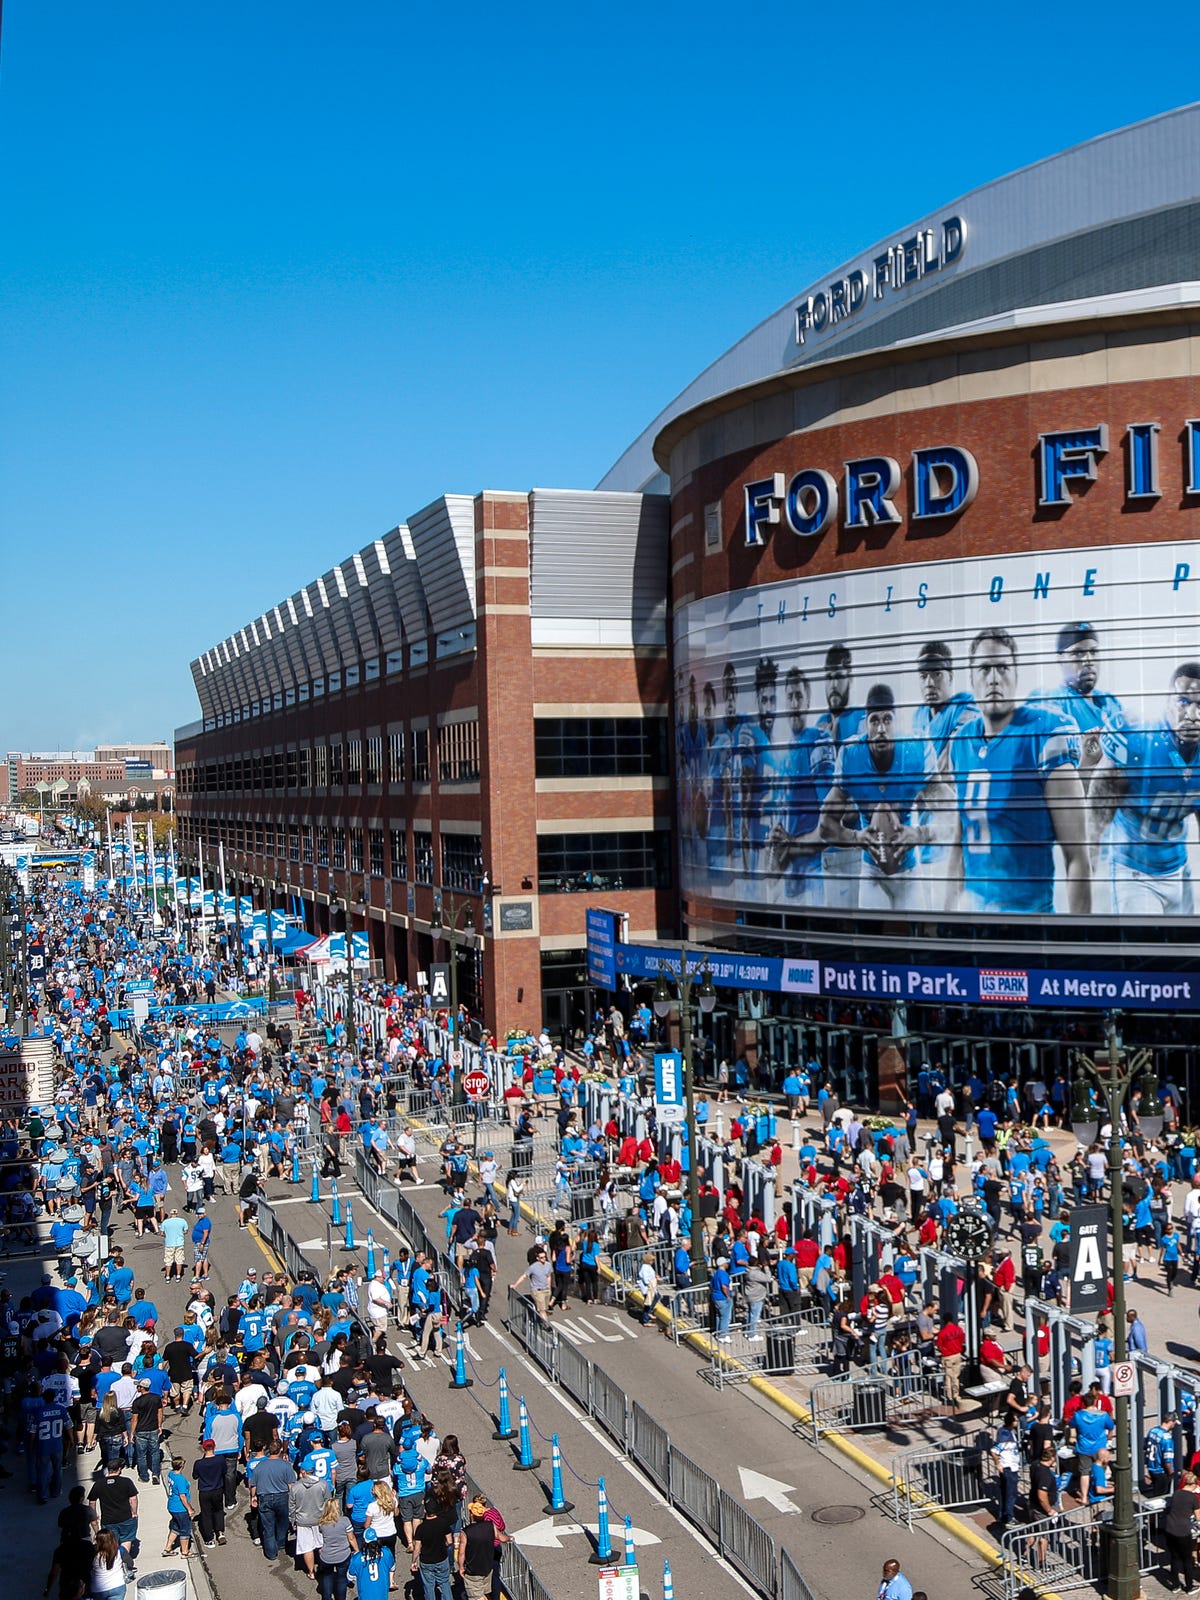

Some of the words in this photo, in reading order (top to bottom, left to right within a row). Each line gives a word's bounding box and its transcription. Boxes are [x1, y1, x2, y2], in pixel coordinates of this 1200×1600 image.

[795, 267, 869, 345] FORD
[872, 215, 968, 300] FIELD
[742, 445, 979, 548] FORD
[757, 592, 837, 628] THIS
[884, 582, 928, 612] IS
[989, 568, 1097, 603] ONE
[738, 964, 769, 981] 4:30PM
[787, 968, 815, 984] HOME
[824, 966, 857, 991] Put
[861, 968, 876, 992] it
[881, 969, 901, 993] in
[907, 970, 968, 996] Park.
[432, 976, 448, 997] A
[981, 975, 996, 991] US
[998, 977, 1026, 992] PARK
[1040, 977, 1060, 996] At
[1064, 978, 1117, 998] Metro
[1121, 980, 1191, 1001] Airport
[465, 1077, 488, 1089] STOP
[661, 1057, 677, 1102] LIONS
[207, 1086, 216, 1096] 15
[1079, 1224, 1099, 1235] GATE
[1025, 1253, 1038, 1266] 12
[1073, 1236, 1104, 1282] A
[250, 1323, 258, 1336] 9
[530, 1313, 639, 1347] NLY
[38, 1418, 63, 1439] 20
[314, 1458, 327, 1478] 9
[368, 1562, 378, 1582] 9
